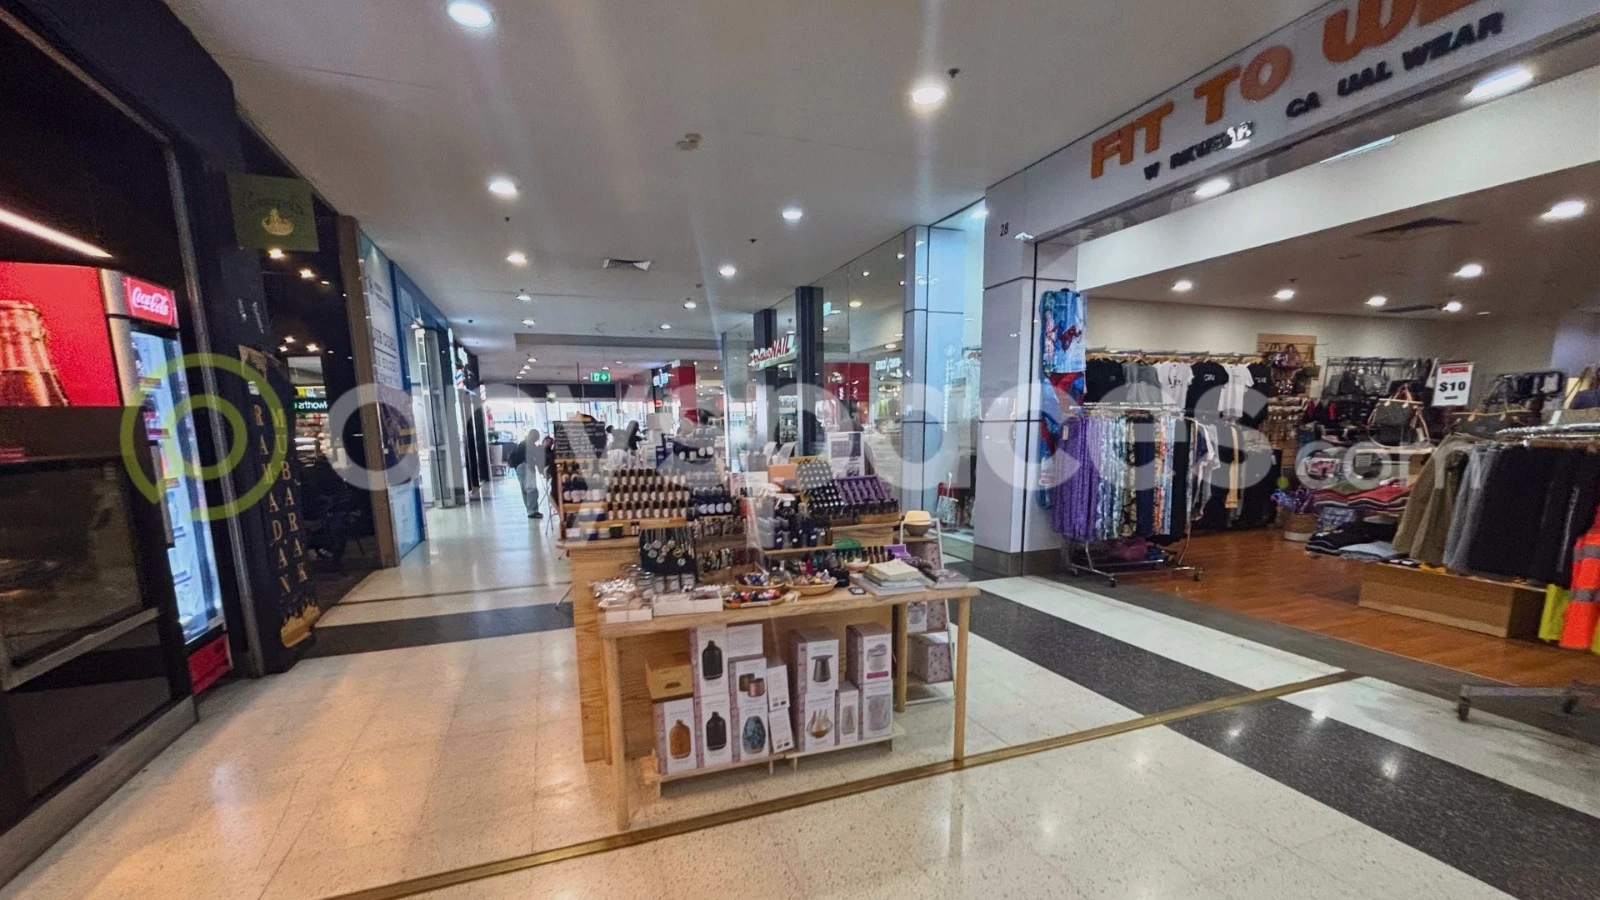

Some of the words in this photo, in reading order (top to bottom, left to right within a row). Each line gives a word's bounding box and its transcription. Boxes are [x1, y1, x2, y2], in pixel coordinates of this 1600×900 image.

[1402, 12, 1504, 71] WEAR
[1091, 100, 1174, 180] FIT
[1193, 45, 1293, 126] TO
[1438, 381, 1467, 392] $10
